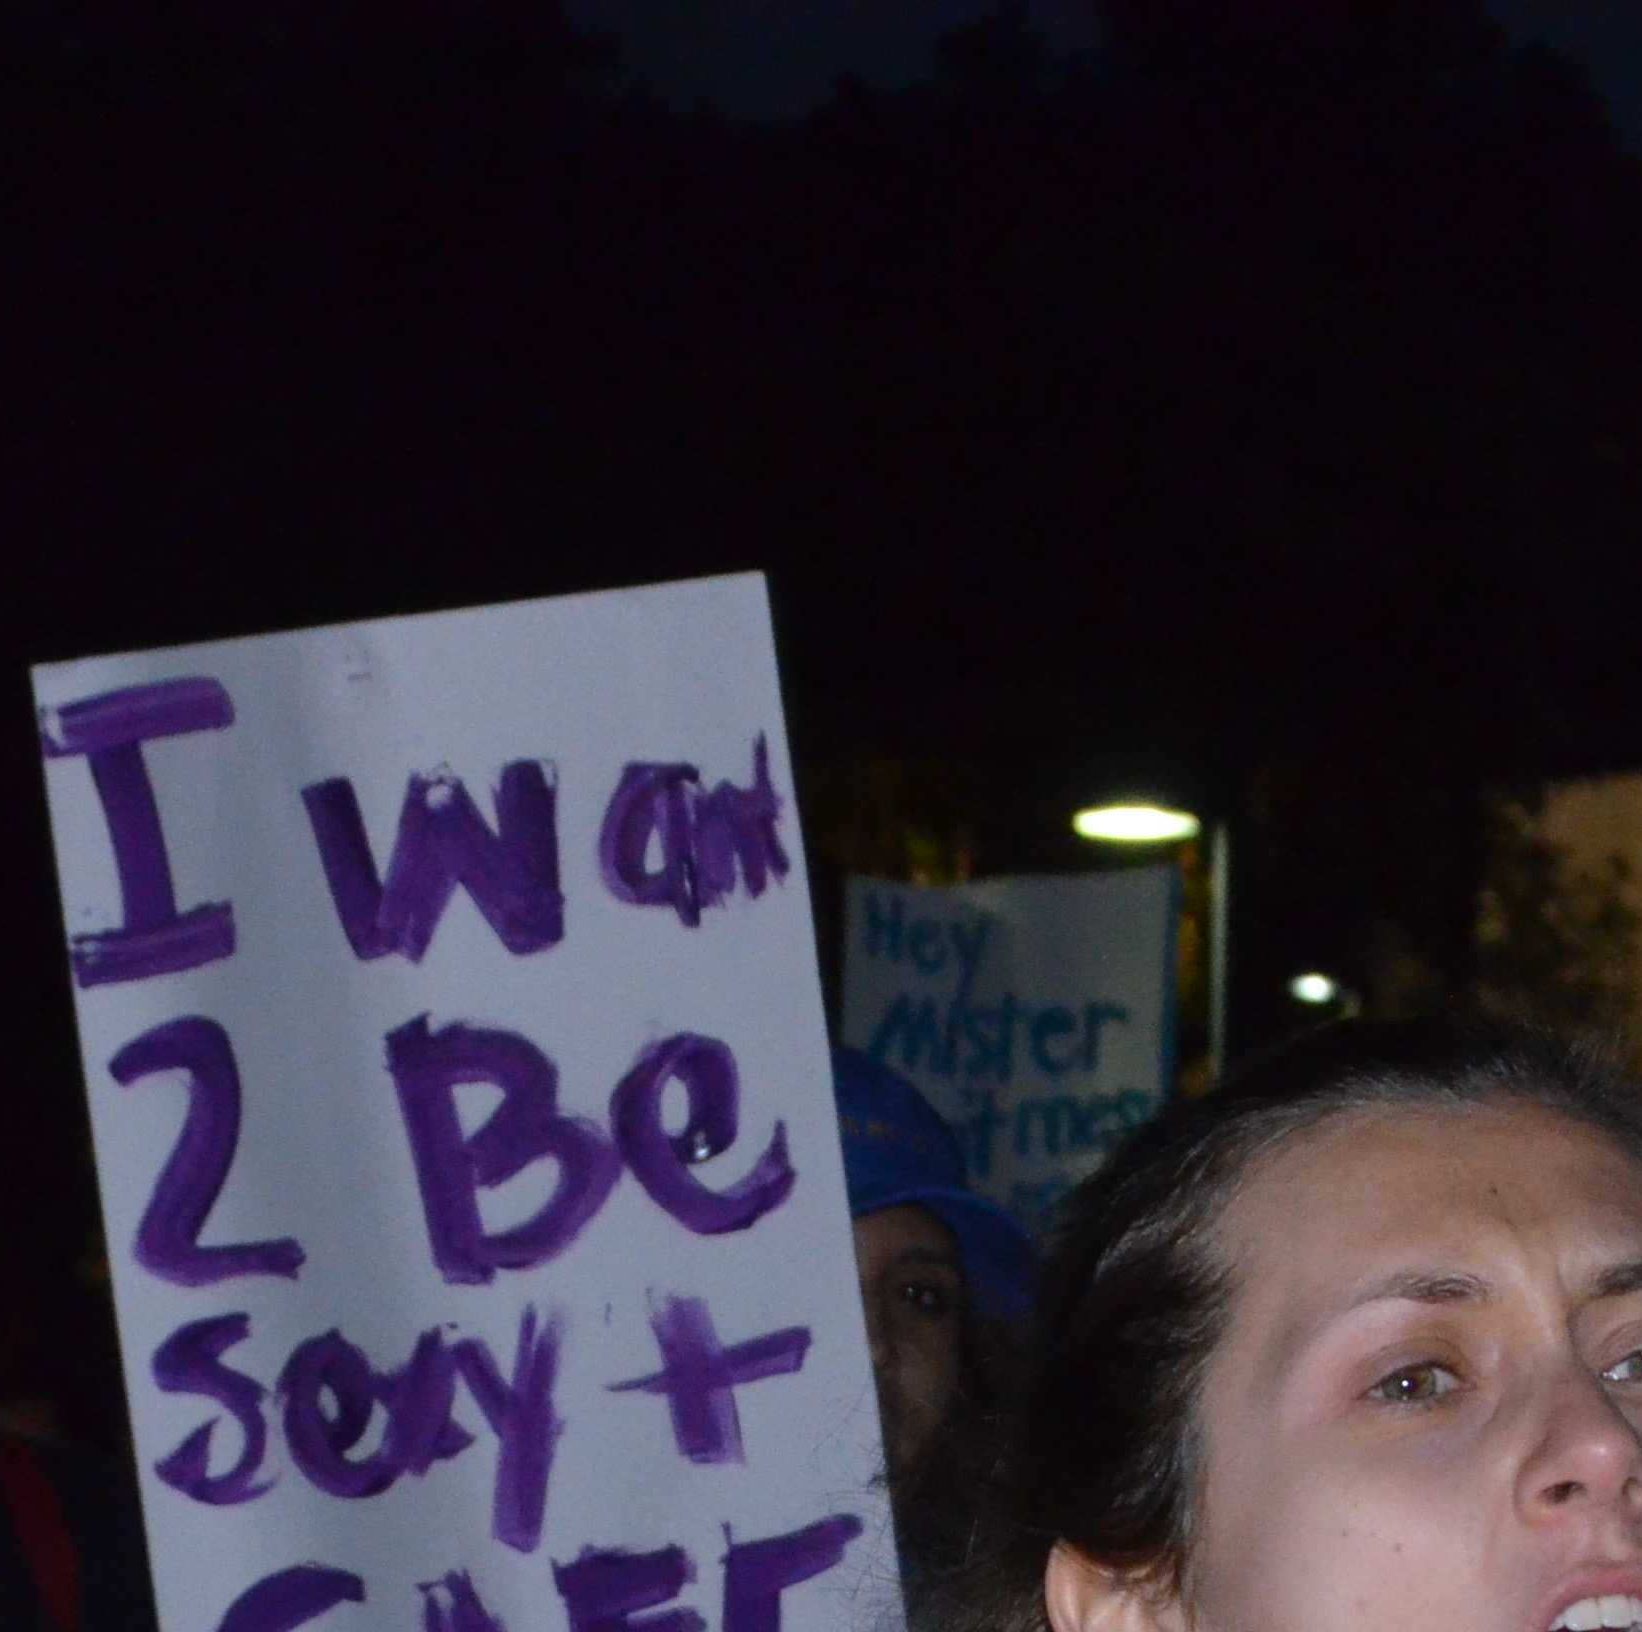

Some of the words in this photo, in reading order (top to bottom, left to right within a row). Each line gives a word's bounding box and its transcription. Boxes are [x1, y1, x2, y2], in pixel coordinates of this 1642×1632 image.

[42, 676, 237, 988] I
[864, 893, 993, 1004] Hey
[109, 1015, 306, 1287] 2
[385, 1012, 797, 1284] Be
